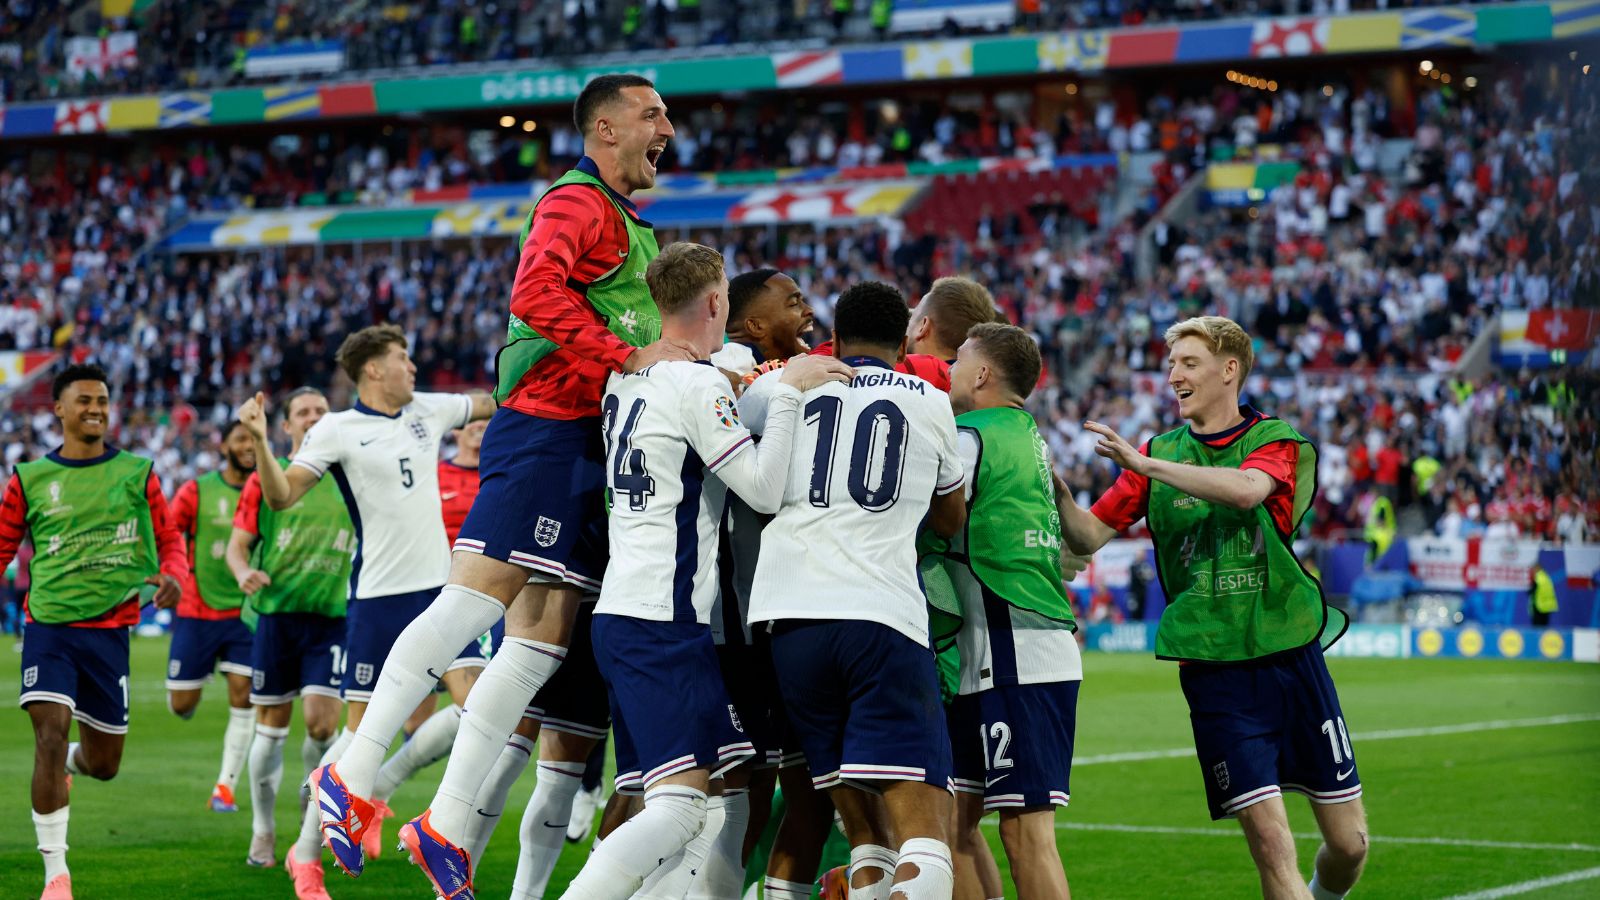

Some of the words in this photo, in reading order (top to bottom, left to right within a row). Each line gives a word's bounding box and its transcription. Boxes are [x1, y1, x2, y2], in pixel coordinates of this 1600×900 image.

[847, 373, 925, 396] INGHAM
[399, 457, 414, 488] 5
[804, 395, 909, 512] 10
[980, 721, 1014, 771] 12
[1321, 716, 1353, 764] 18
